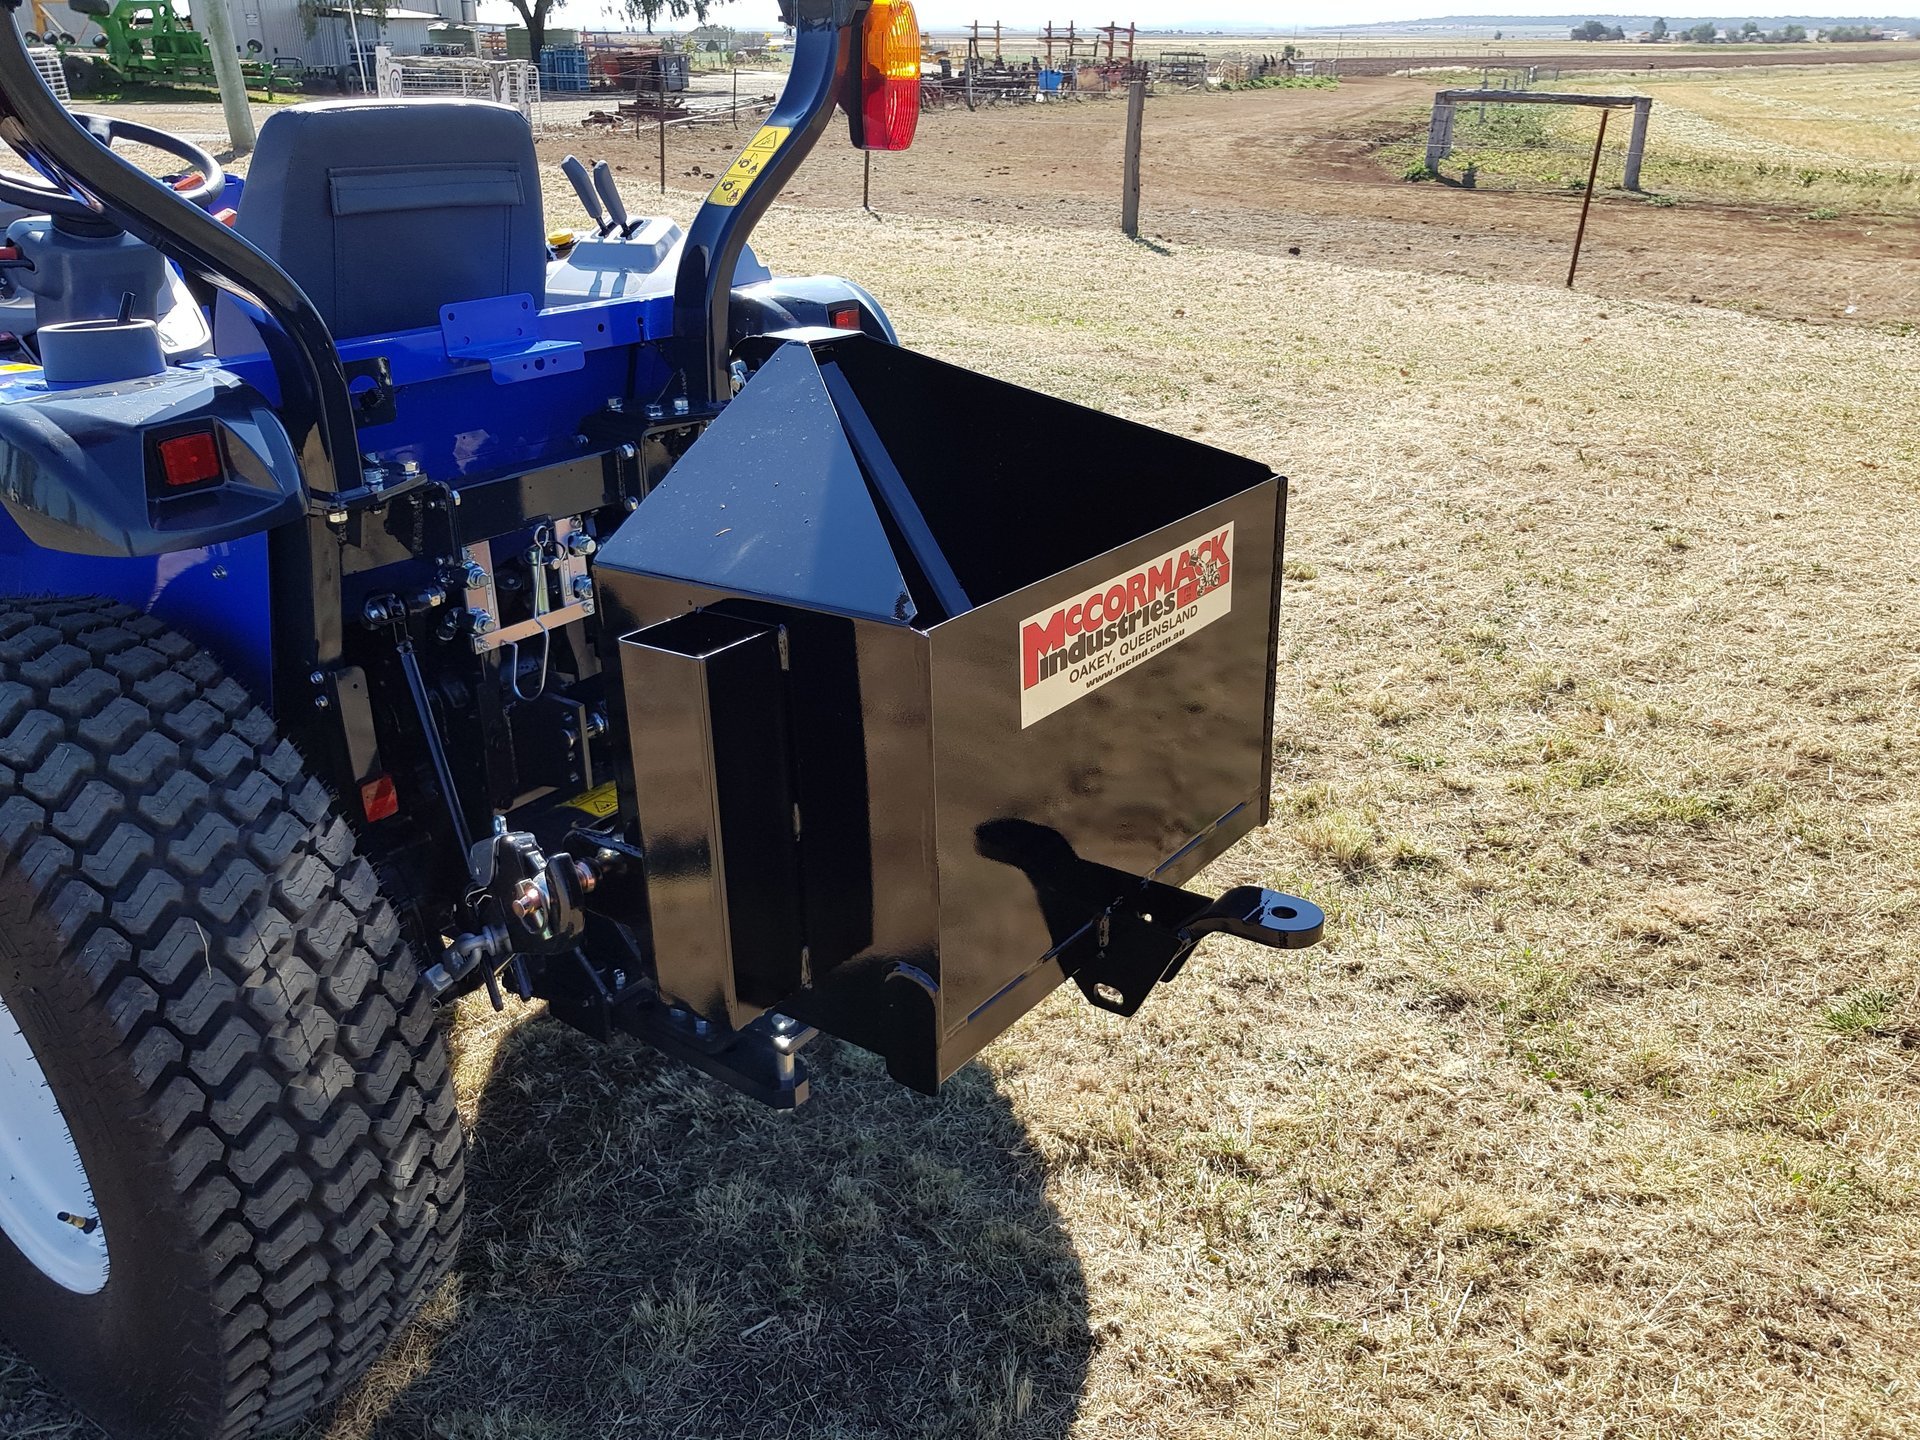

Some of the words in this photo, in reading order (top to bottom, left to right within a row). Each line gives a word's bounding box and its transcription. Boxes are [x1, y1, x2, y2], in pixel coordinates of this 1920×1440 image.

[1069, 653, 1116, 683] OAKEY,
[1119, 605, 1198, 657] QUEENSLAND
[1086, 628, 1185, 688] www.mcind.com.au
